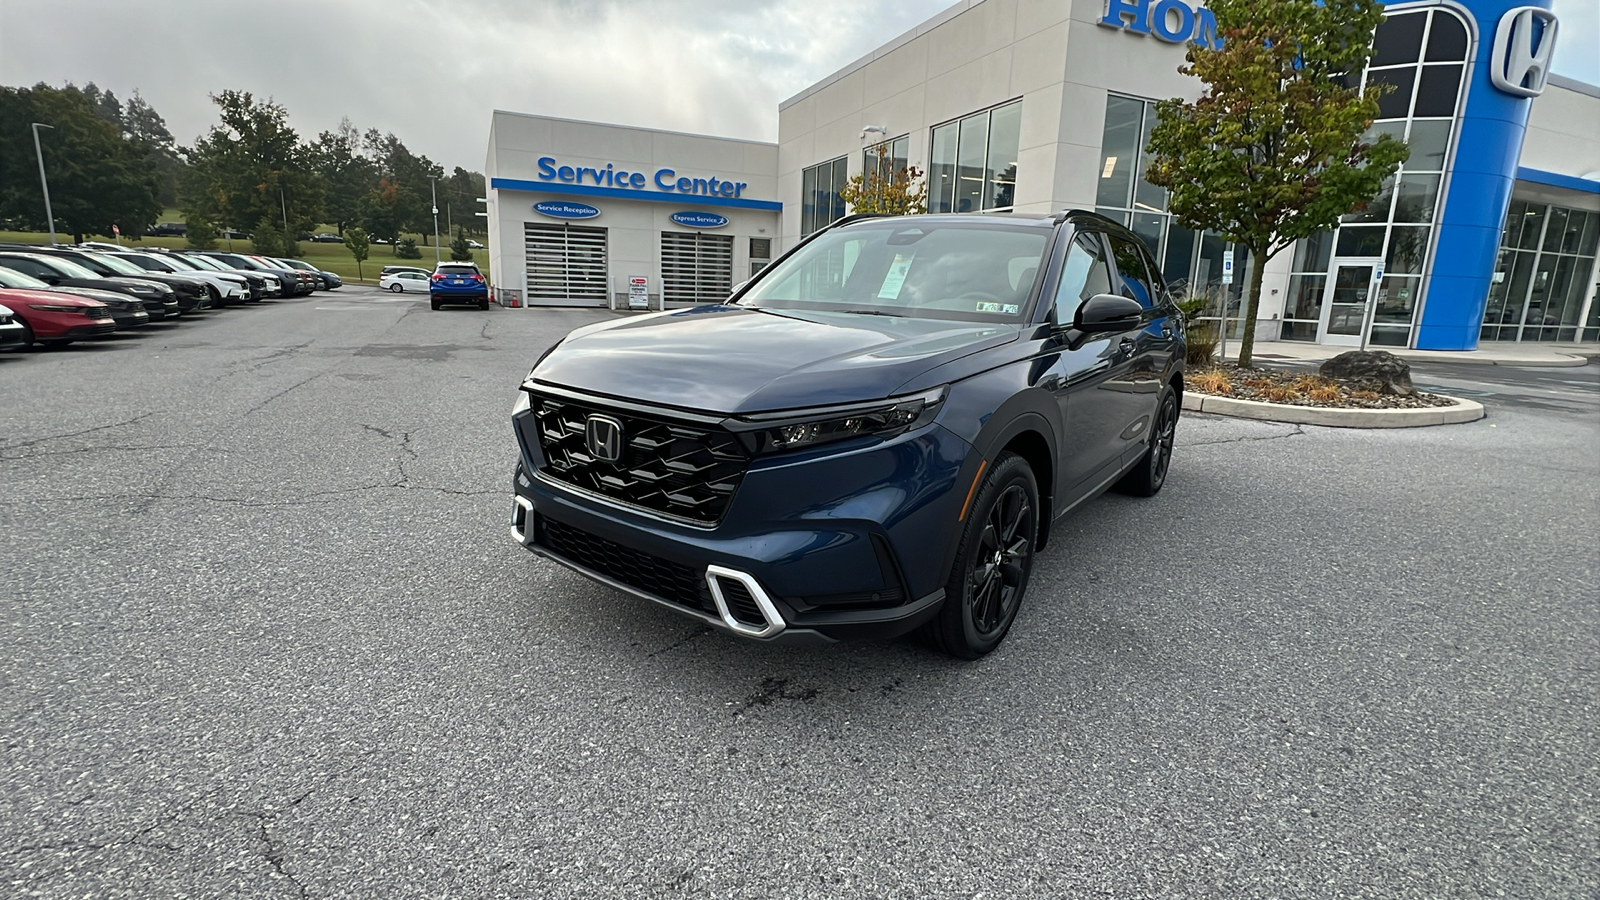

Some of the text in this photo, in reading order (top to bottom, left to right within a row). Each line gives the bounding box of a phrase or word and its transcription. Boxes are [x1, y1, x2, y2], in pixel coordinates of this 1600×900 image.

[1098, 0, 1226, 50] HON
[538, 156, 747, 198] Service Center
[537, 204, 597, 215] Service Reception
[673, 214, 718, 224] Express Service
